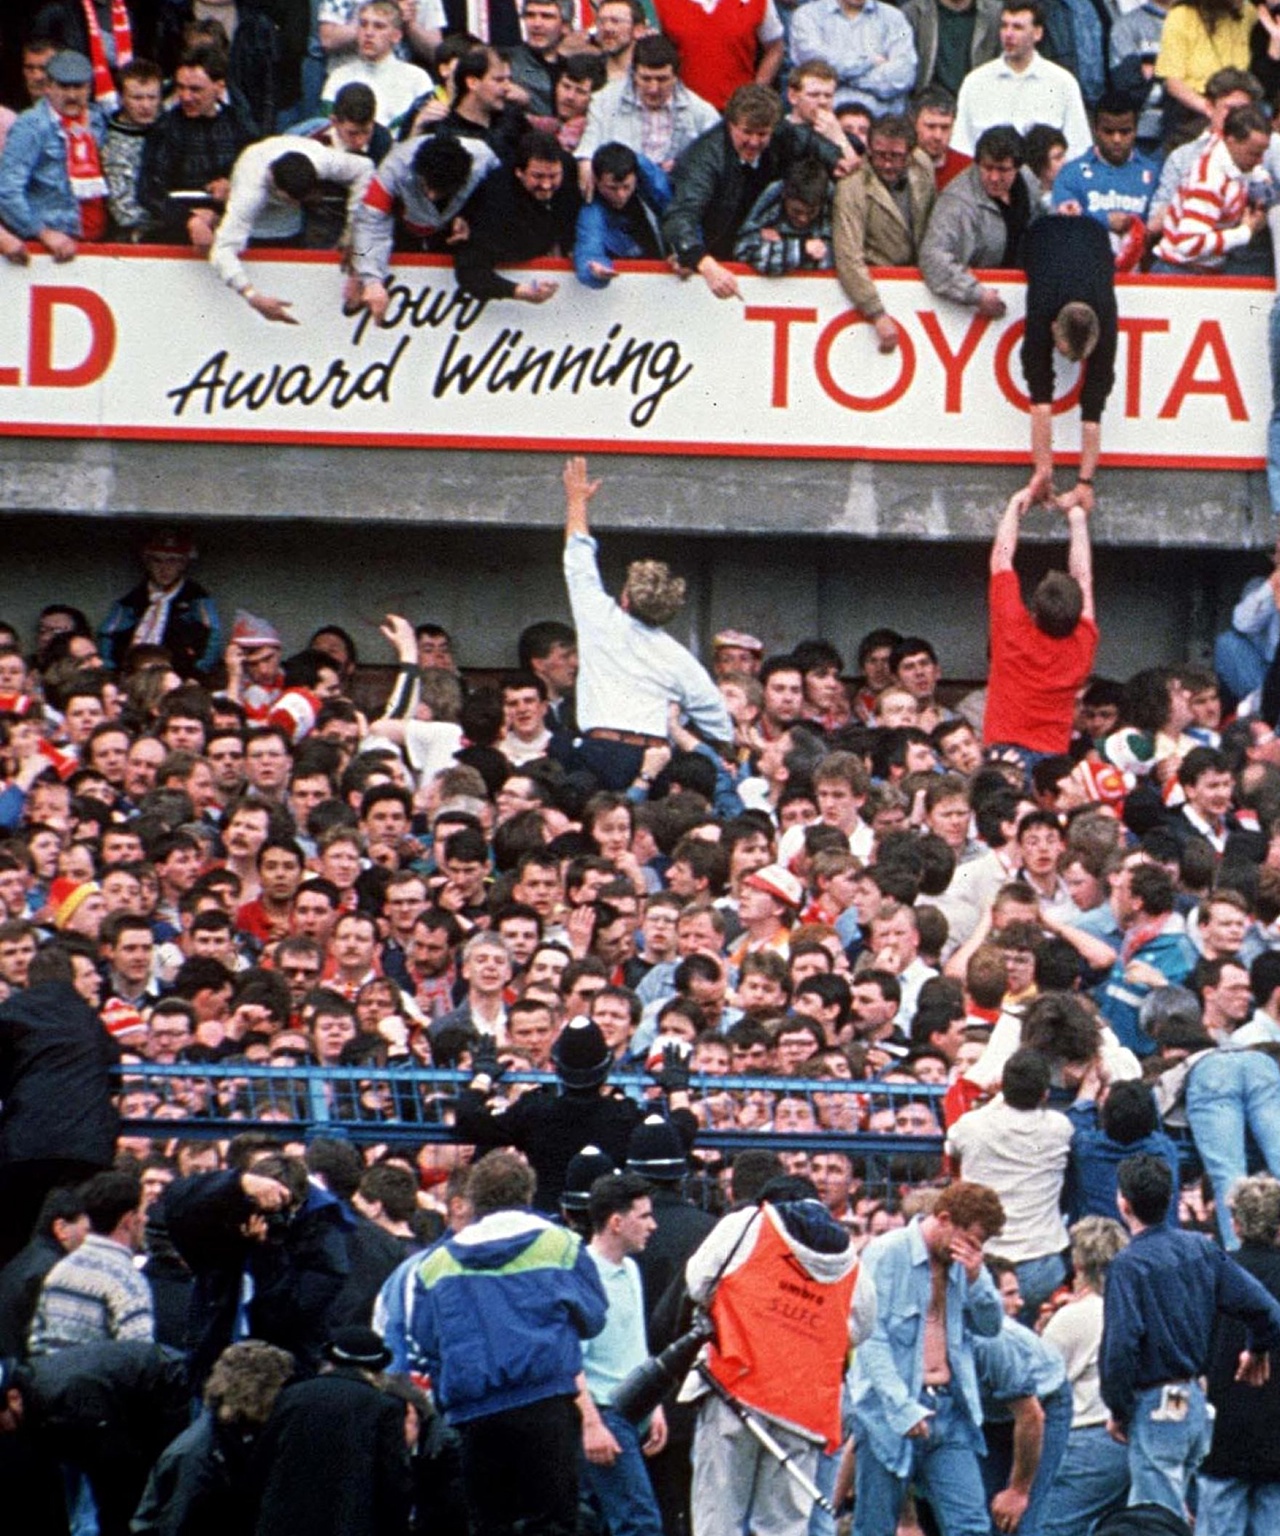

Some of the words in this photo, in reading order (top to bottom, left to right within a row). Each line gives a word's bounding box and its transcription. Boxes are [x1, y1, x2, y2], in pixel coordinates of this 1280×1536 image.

[0, 284, 117, 387] D
[167, 334, 411, 416] Award
[432, 323, 694, 427] Winning
[745, 306, 1250, 421] TOYOTA
[778, 1279, 824, 1307] umbro
